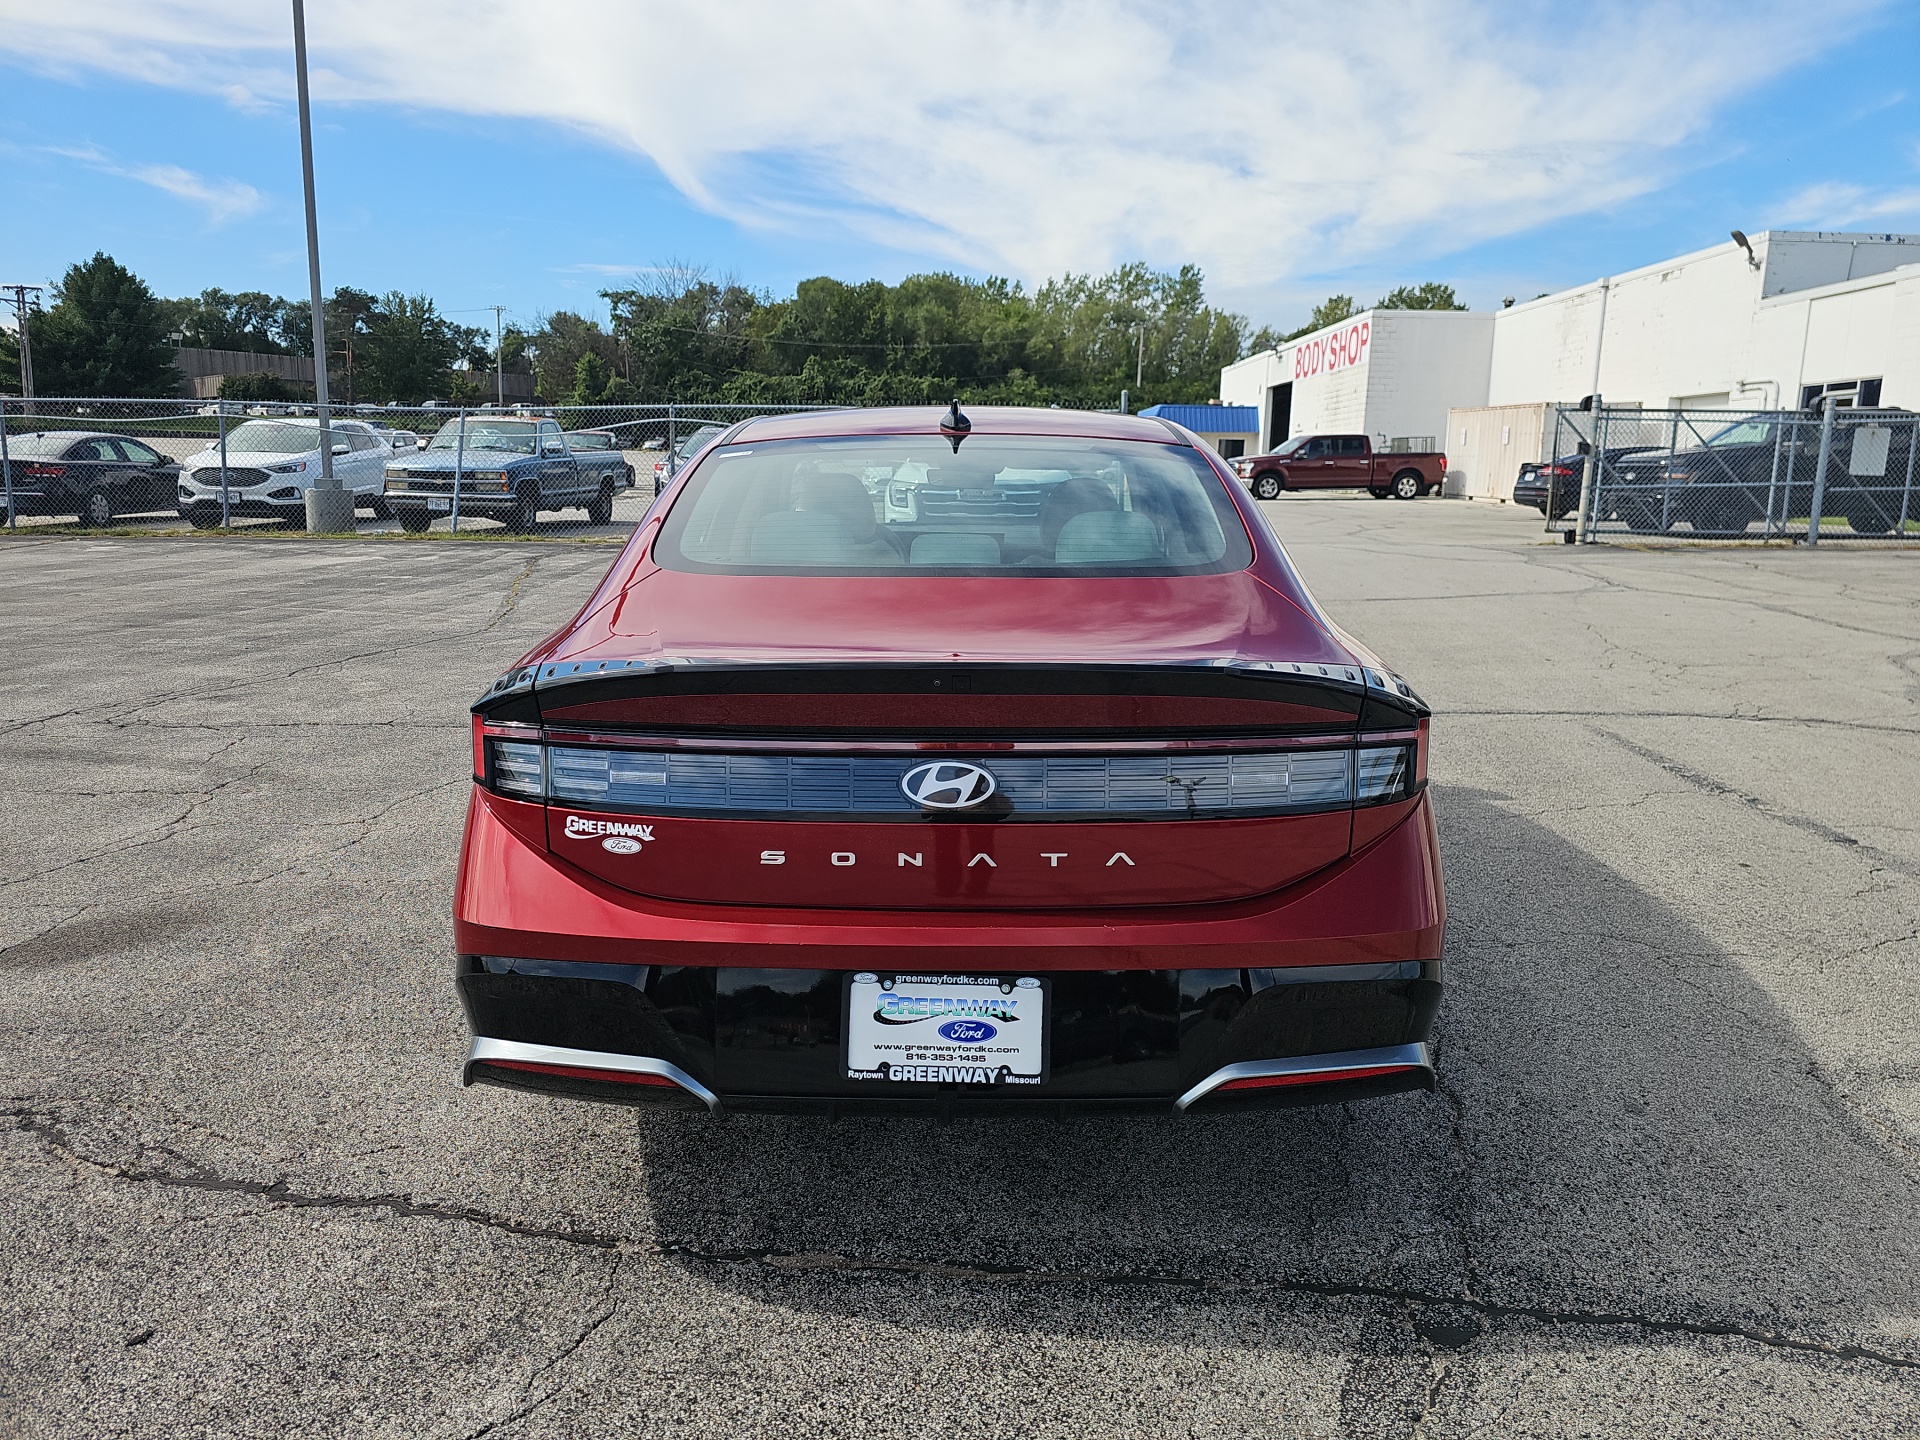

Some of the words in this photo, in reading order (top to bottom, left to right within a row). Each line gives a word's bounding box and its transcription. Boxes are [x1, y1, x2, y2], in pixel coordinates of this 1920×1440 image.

[566, 815, 653, 837] GREENWAY
[610, 840, 634, 851] Ford
[760, 850, 1136, 867] SONATA
[895, 974, 999, 986] greenwayfordkc.com
[877, 993, 1018, 1018] GREENWAY
[950, 1021, 985, 1039] Ford
[873, 1043, 1020, 1054] www.greenwayfordkc.com
[905, 1053, 986, 1063] 816-353-1495
[848, 1070, 884, 1080] Raytown
[889, 1065, 999, 1084] GREENWAY
[1005, 1075, 1041, 1085] Missouri
